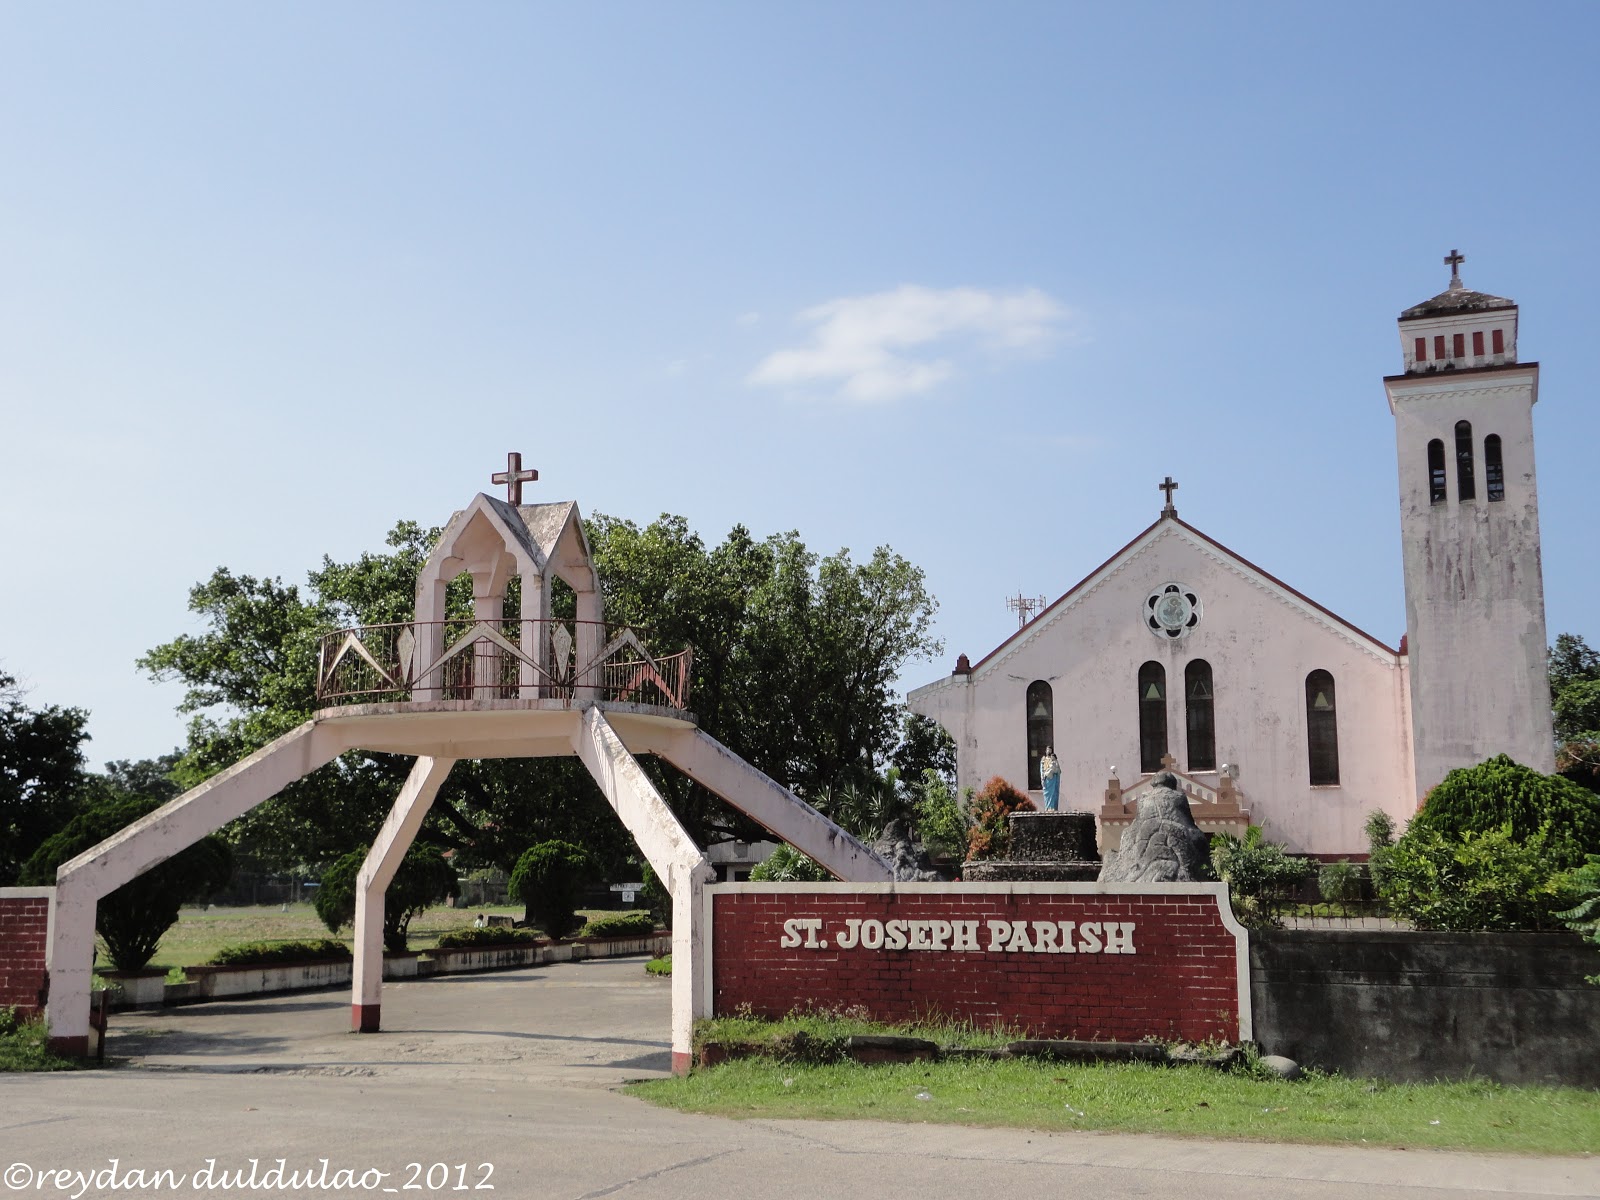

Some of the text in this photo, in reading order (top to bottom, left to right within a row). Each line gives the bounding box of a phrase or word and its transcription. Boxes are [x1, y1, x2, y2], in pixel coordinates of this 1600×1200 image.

[781, 919, 1137, 954] ST. JOSEPH PARISH
